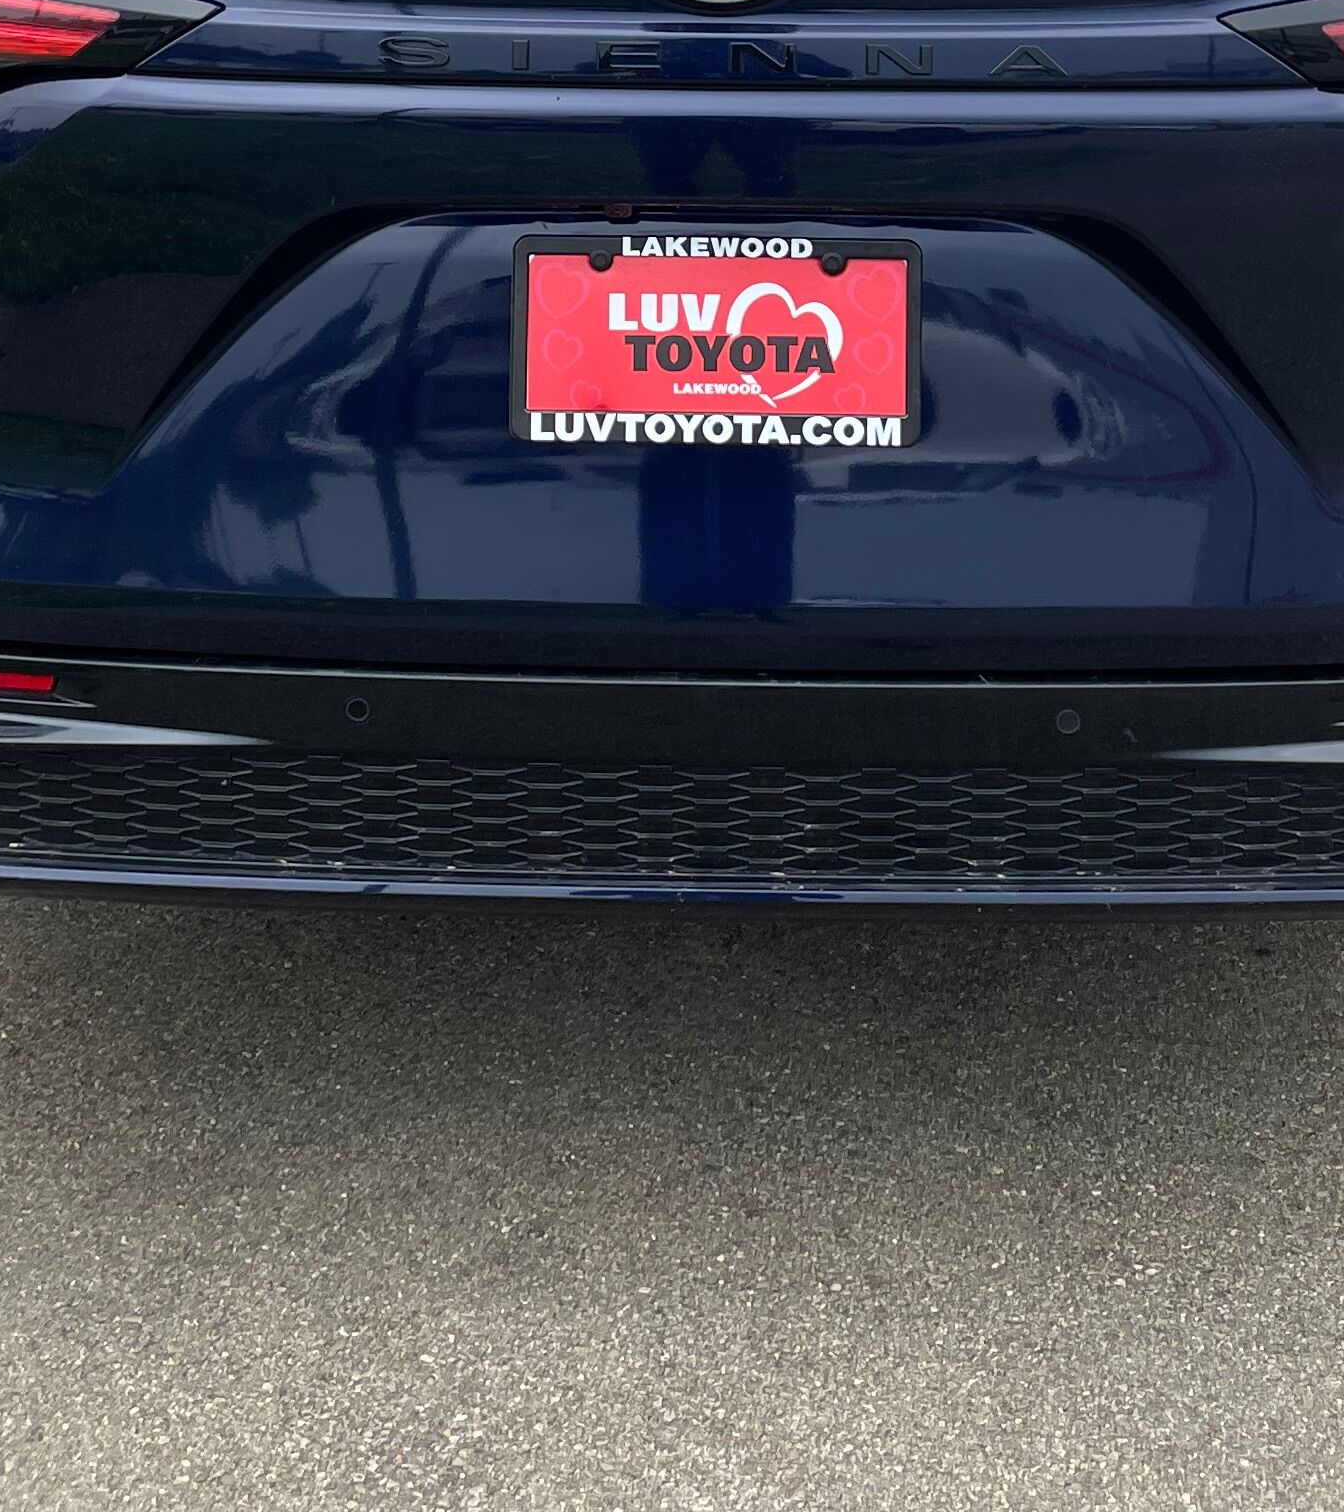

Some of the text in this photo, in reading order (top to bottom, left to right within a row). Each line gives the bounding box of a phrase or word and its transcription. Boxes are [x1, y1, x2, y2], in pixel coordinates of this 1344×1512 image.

[376, 36, 1069, 78] SIENNA
[621, 236, 814, 259] LAKEWOOD
[608, 293, 722, 332] LUV
[624, 335, 836, 374] TOYOTA
[673, 383, 762, 395] LAKEWOOD
[529, 412, 903, 446] LUVTOYOTA.COM
